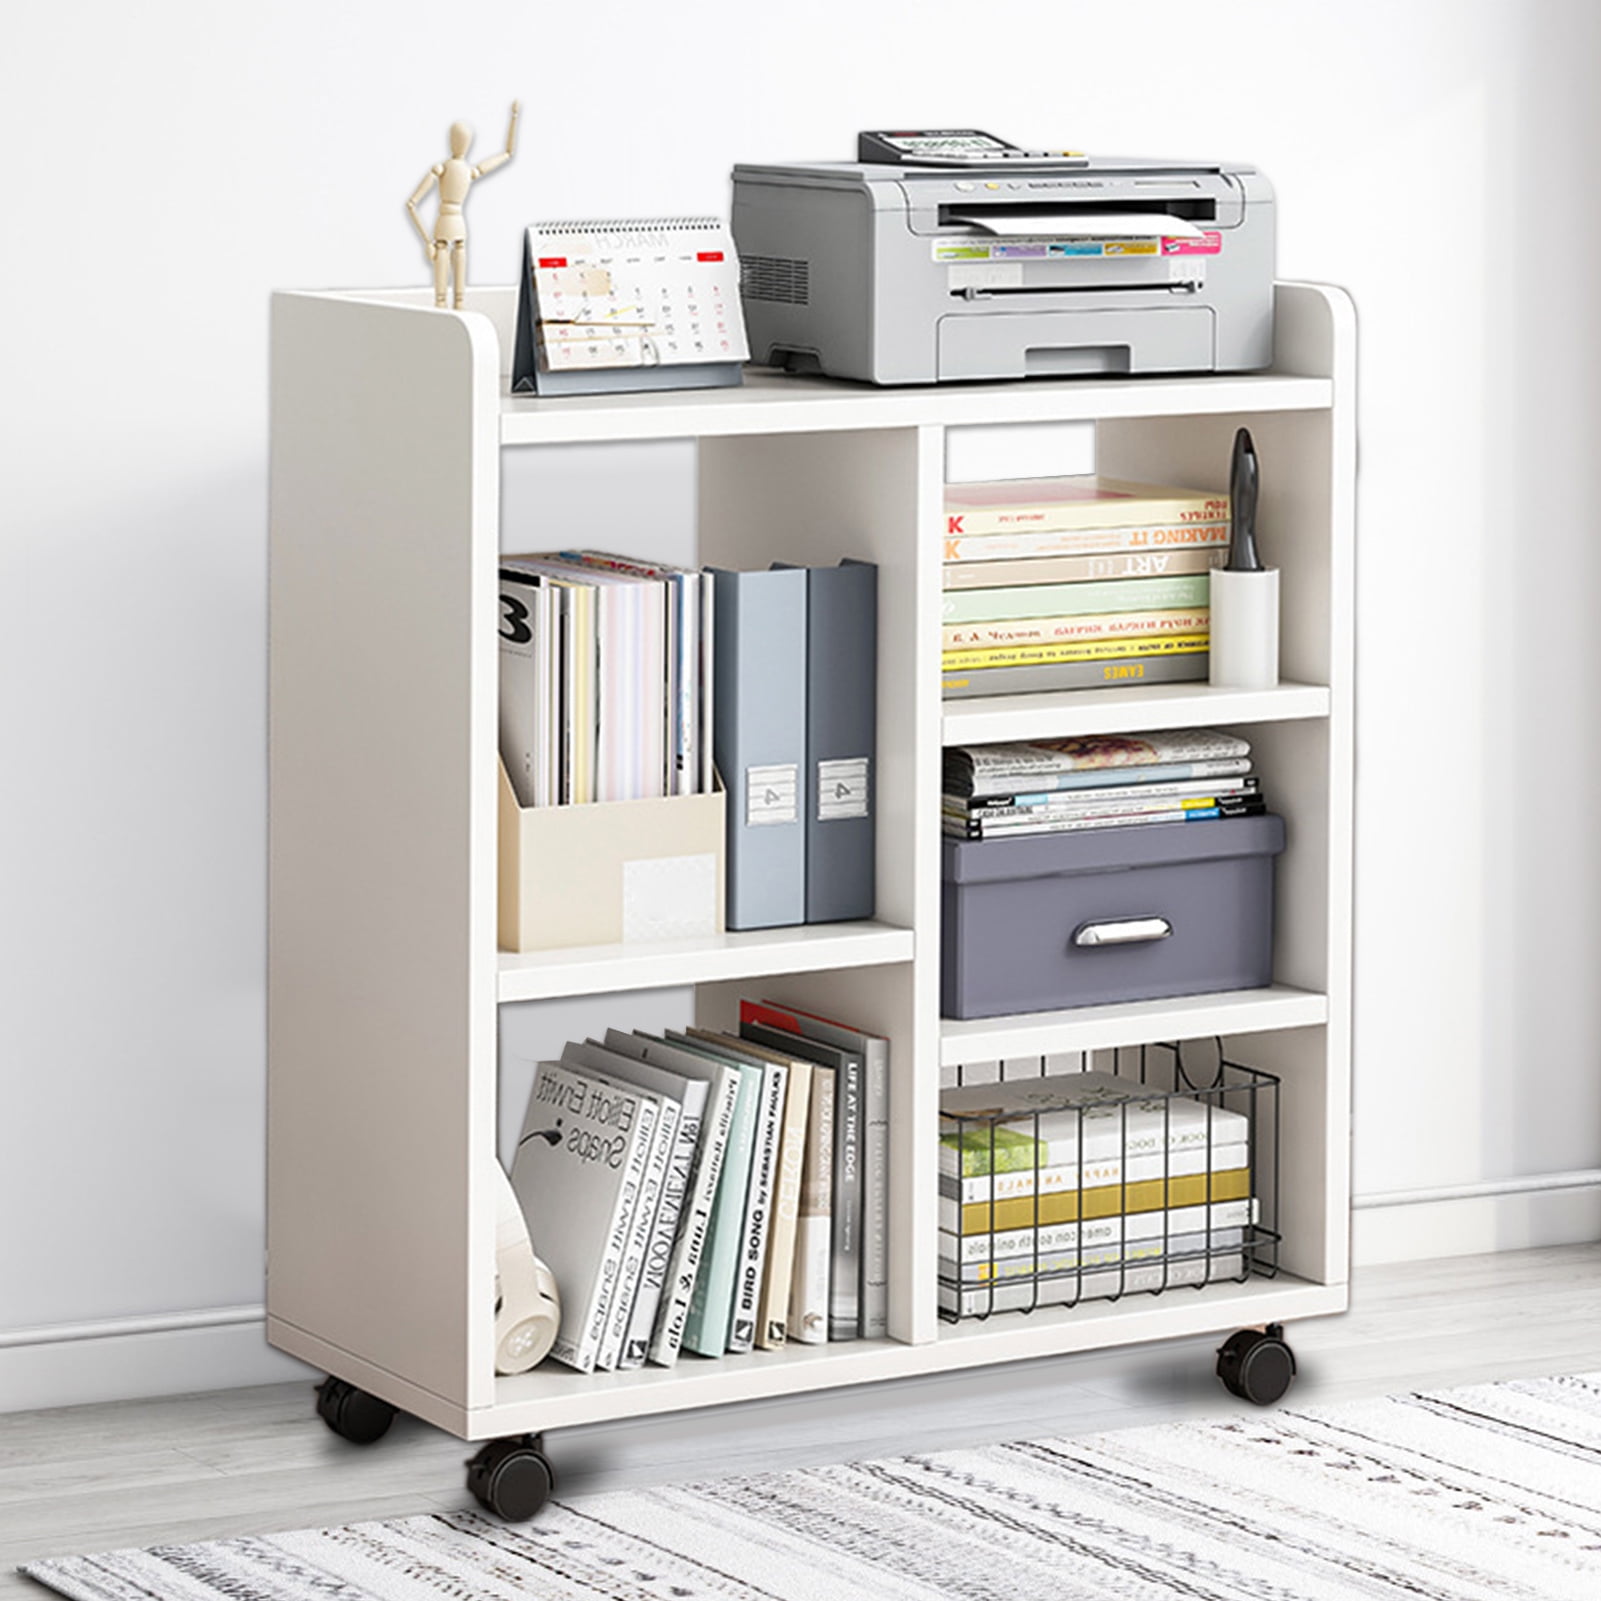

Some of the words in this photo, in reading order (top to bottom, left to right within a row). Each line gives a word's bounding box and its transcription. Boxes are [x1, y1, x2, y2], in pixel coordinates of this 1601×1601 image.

[1129, 531, 1147, 547] IT
[1152, 526, 1228, 546] MAKING
[1122, 555, 1170, 576] ART
[1104, 664, 1145, 681] EAMES
[847, 1062, 858, 1091] LIFE
[769, 1071, 781, 1118] FAULKS
[847, 1093, 857, 1112] AT
[846, 1115, 857, 1142] THE
[760, 1121, 775, 1187] SEBASTIAN
[845, 1144, 856, 1183] EDGE
[748, 1209, 764, 1262] SONG
[741, 1265, 757, 1311] BIRD
